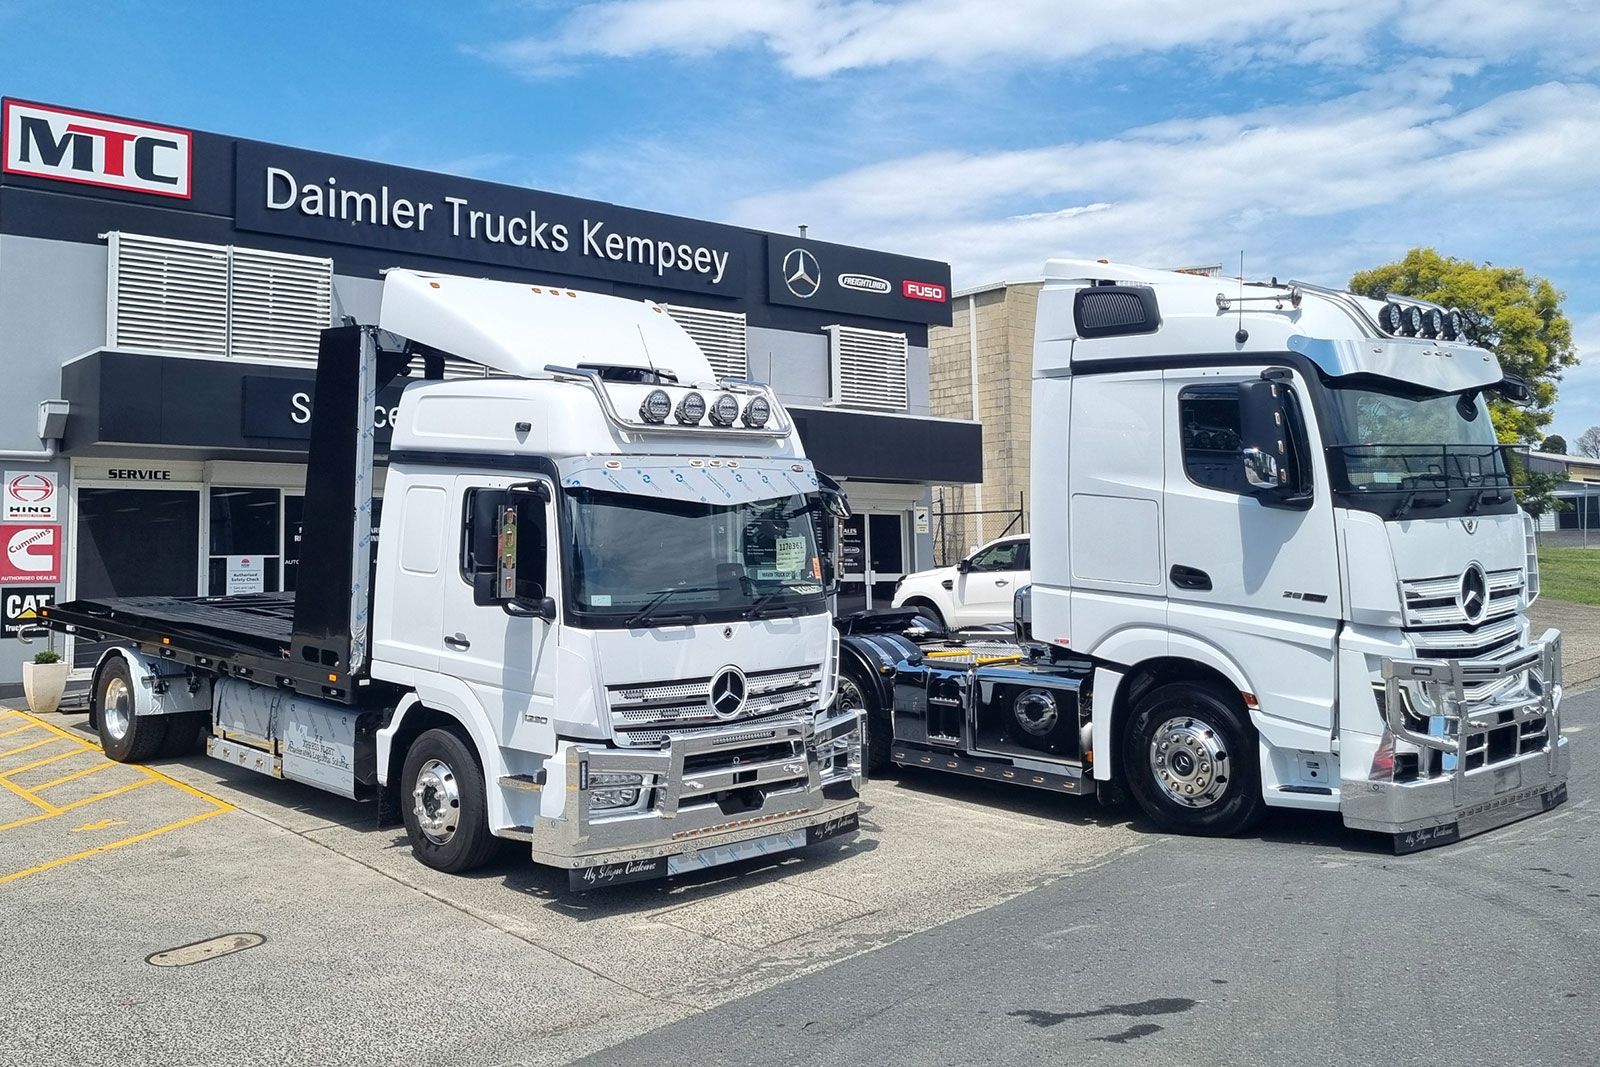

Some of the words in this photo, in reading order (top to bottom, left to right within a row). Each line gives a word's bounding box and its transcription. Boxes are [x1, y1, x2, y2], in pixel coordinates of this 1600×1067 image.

[19, 115, 178, 185] MTC
[267, 167, 433, 231] Daimler
[445, 196, 569, 252] Trucks
[583, 219, 729, 284] Kempsey
[843, 277, 886, 290] FREIGHTLINER
[907, 284, 942, 299] FUSO
[108, 469, 171, 480] SERVICE
[9, 529, 51, 553] Cummins
[779, 541, 803, 551] 1170361
[6, 594, 51, 619] CAT
